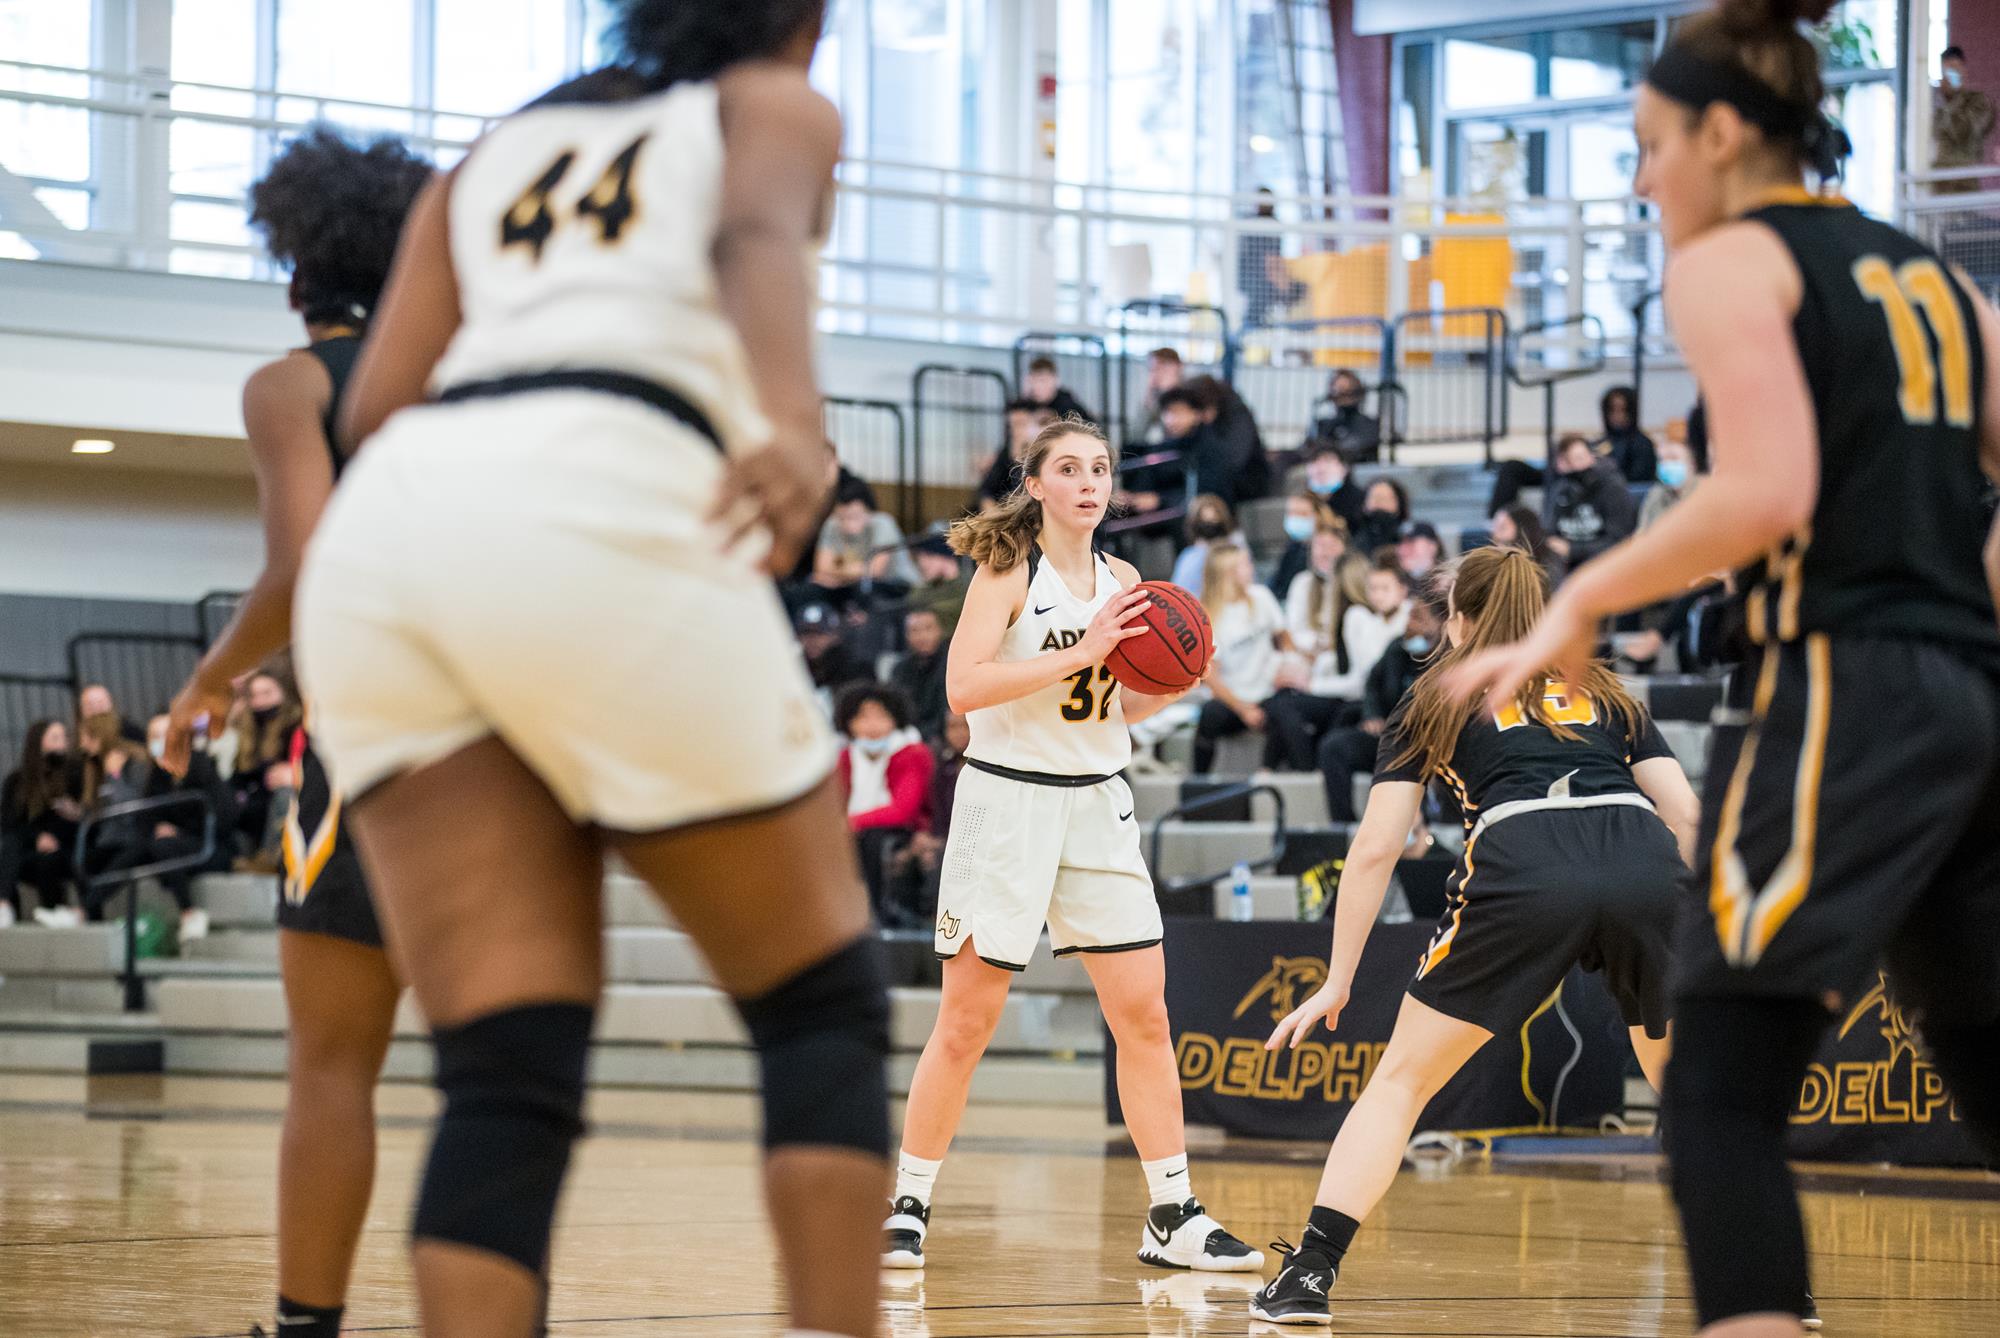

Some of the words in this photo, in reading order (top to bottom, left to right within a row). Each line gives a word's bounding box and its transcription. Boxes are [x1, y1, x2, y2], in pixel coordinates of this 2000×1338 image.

[497, 131, 653, 267] 44
[1852, 254, 1974, 428] 11
[1060, 664, 1118, 723] 32
[1787, 1060, 1962, 1125] DELP
